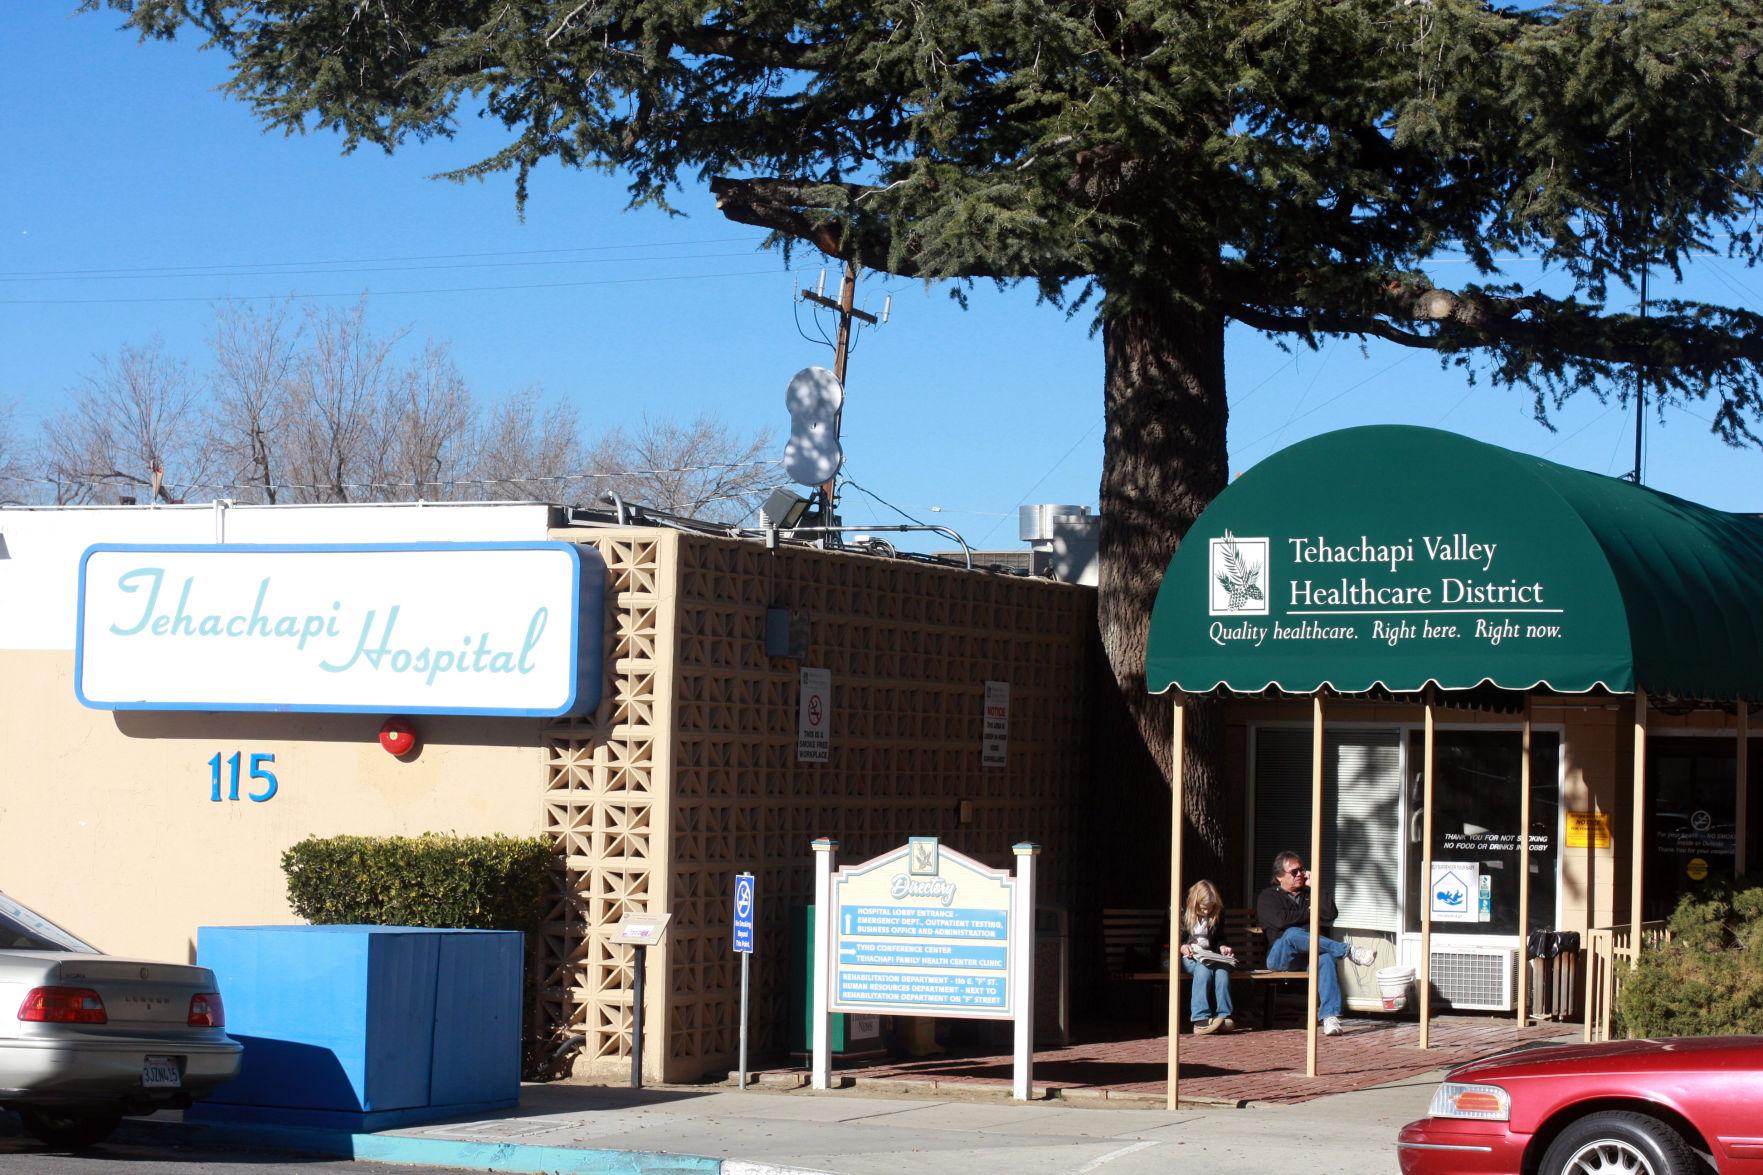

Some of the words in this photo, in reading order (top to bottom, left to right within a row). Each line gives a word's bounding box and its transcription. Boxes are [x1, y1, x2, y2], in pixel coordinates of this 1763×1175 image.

[1289, 535, 1415, 572] Tehachapi
[1422, 533, 1498, 571] Valley
[1290, 579, 1432, 606] Healthcare
[1441, 578, 1544, 604] District
[109, 567, 341, 650] Tehachapi
[318, 604, 549, 686] Hospital
[1209, 621, 1268, 647] Quality
[1273, 620, 1359, 641] healthcare.
[1371, 619, 1417, 647] Right
[1422, 619, 1462, 640] here.
[1474, 618, 1520, 646] Right
[1526, 625, 1563, 639] now.
[803, 730, 814, 738] THIS
[799, 740, 816, 749] SMOKE
[817, 741, 828, 749] FREE
[799, 750, 828, 759] WORKPLACE
[207, 750, 279, 803] 115
[1455, 842, 1475, 850] FOOD
[891, 873, 957, 907] Directory
[925, 919, 969, 927] OUTPATIENT
[934, 929, 996, 937] ADMINISTRATION
[877, 945, 923, 953] CONFERENCE
[924, 946, 952, 954] CENTER
[896, 956, 921, 964] FAMILY
[922, 957, 949, 965] HEALTH
[949, 958, 977, 966] CENTER
[978, 959, 1003, 967] CLINIC
[843, 973, 900, 981] REHABILITATION
[901, 975, 948, 984] DEPARTMENT
[869, 984, 910, 992] RESOURCES
[911, 985, 960, 993] DEPARTMENT
[843, 992, 899, 1000] REHABILITATION
[974, 996, 1001, 1004] STREET
